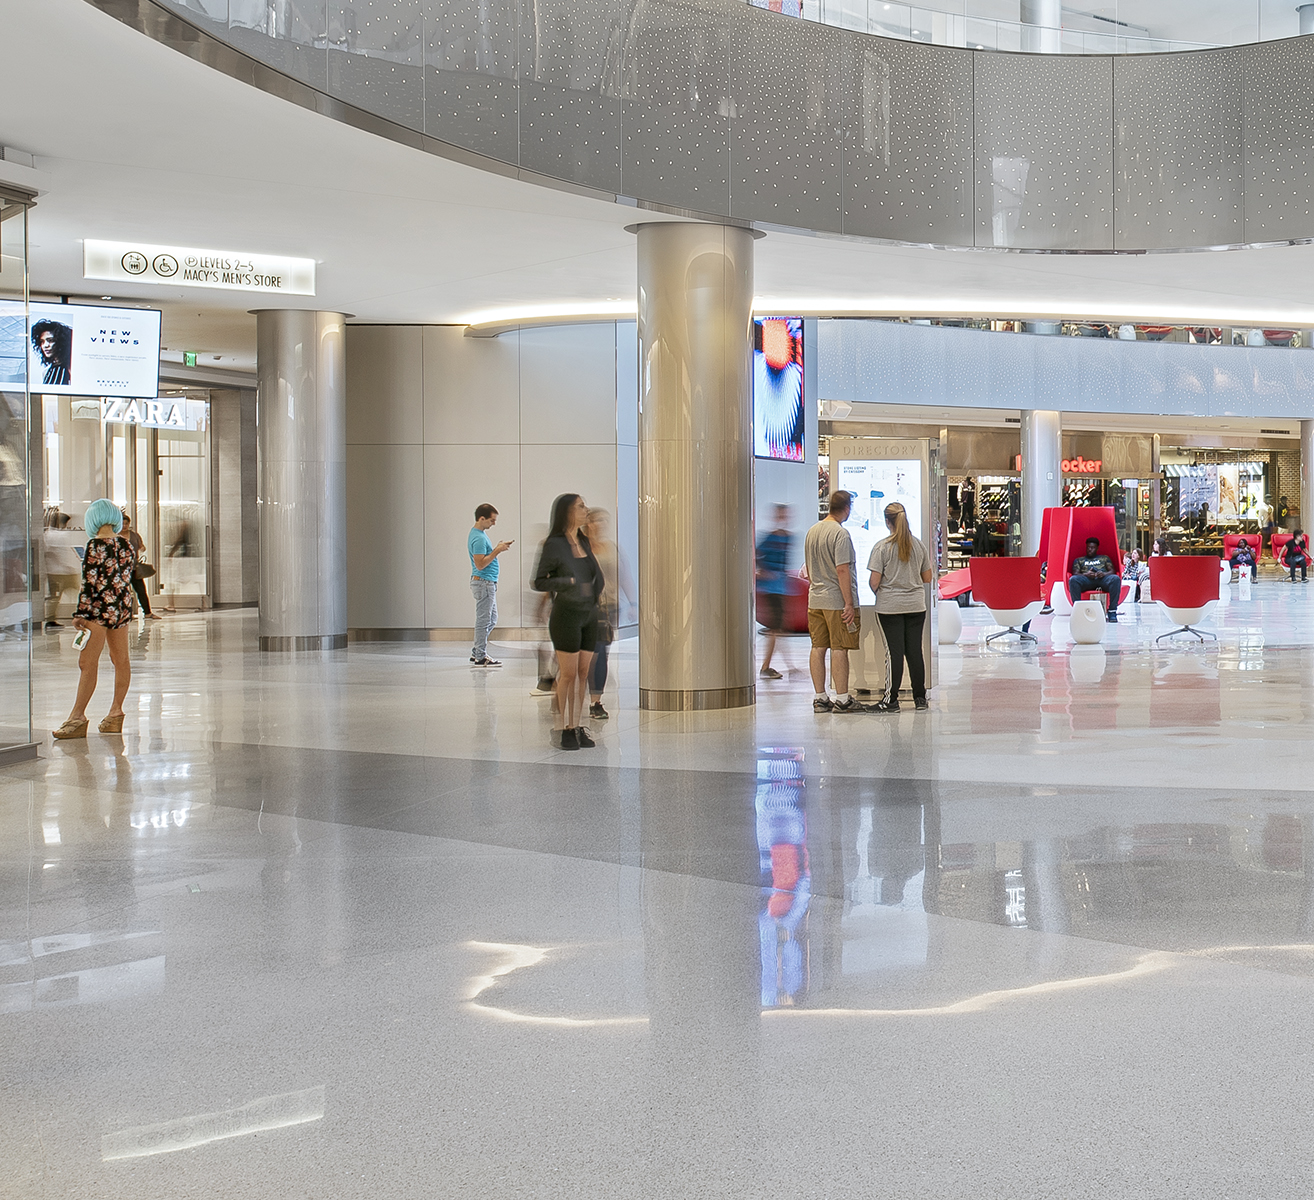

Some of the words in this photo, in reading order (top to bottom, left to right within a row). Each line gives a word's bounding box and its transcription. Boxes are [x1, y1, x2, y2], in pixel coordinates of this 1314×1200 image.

[200, 257, 231, 270] LEVELS
[183, 269, 219, 283] MACY'S
[222, 273, 251, 286] MEN'S
[254, 275, 282, 288] STORE
[90, 337, 140, 346] VIEWS
[103, 397, 186, 426] ZARA
[843, 445, 917, 456] DIRECTORY
[1060, 456, 1102, 473] ocker
